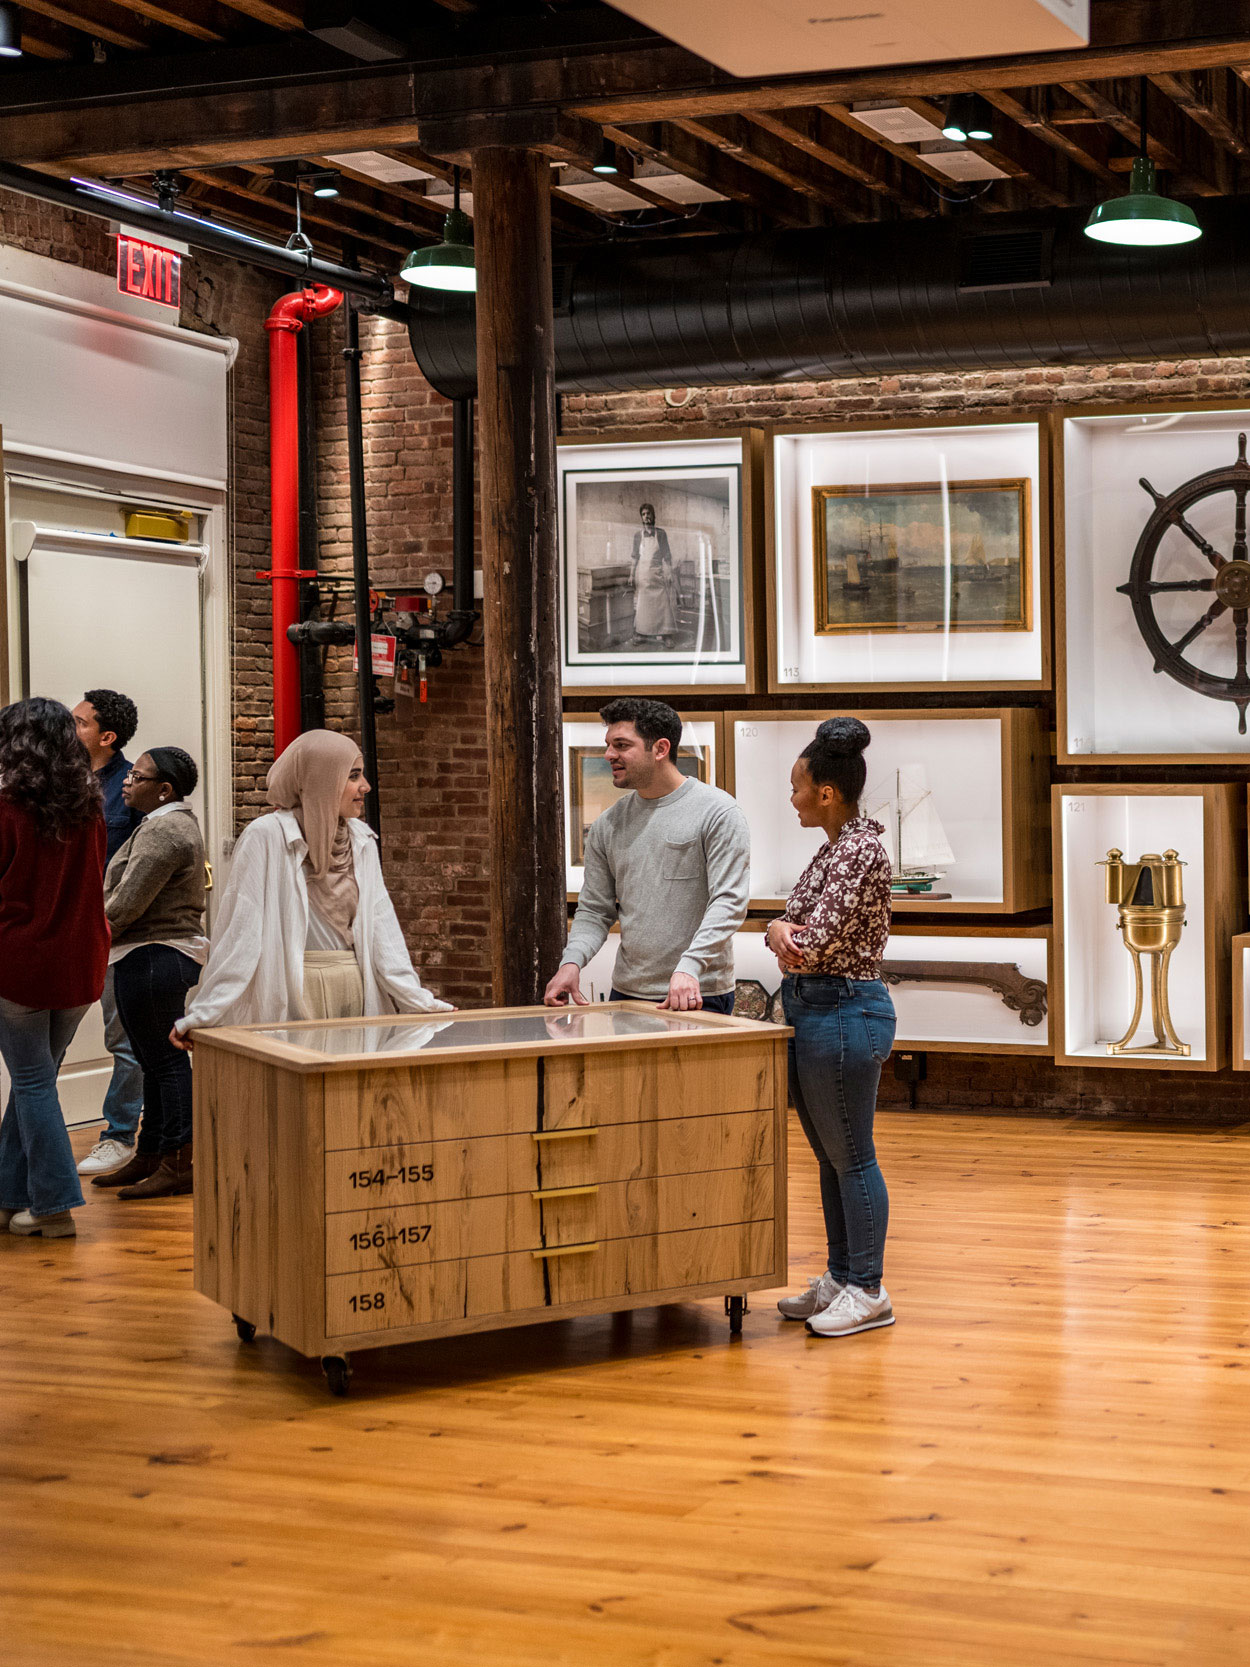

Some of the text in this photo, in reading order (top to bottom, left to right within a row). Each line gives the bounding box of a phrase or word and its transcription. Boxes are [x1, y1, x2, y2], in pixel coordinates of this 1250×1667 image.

[127, 239, 175, 303] EXIT
[783, 667, 800, 678] 113
[740, 727, 759, 738] 120
[1068, 802, 1085, 812] 121
[349, 1164, 434, 1189] 154–155
[349, 1225, 432, 1251] 156–157
[349, 1292, 385, 1313] 158
